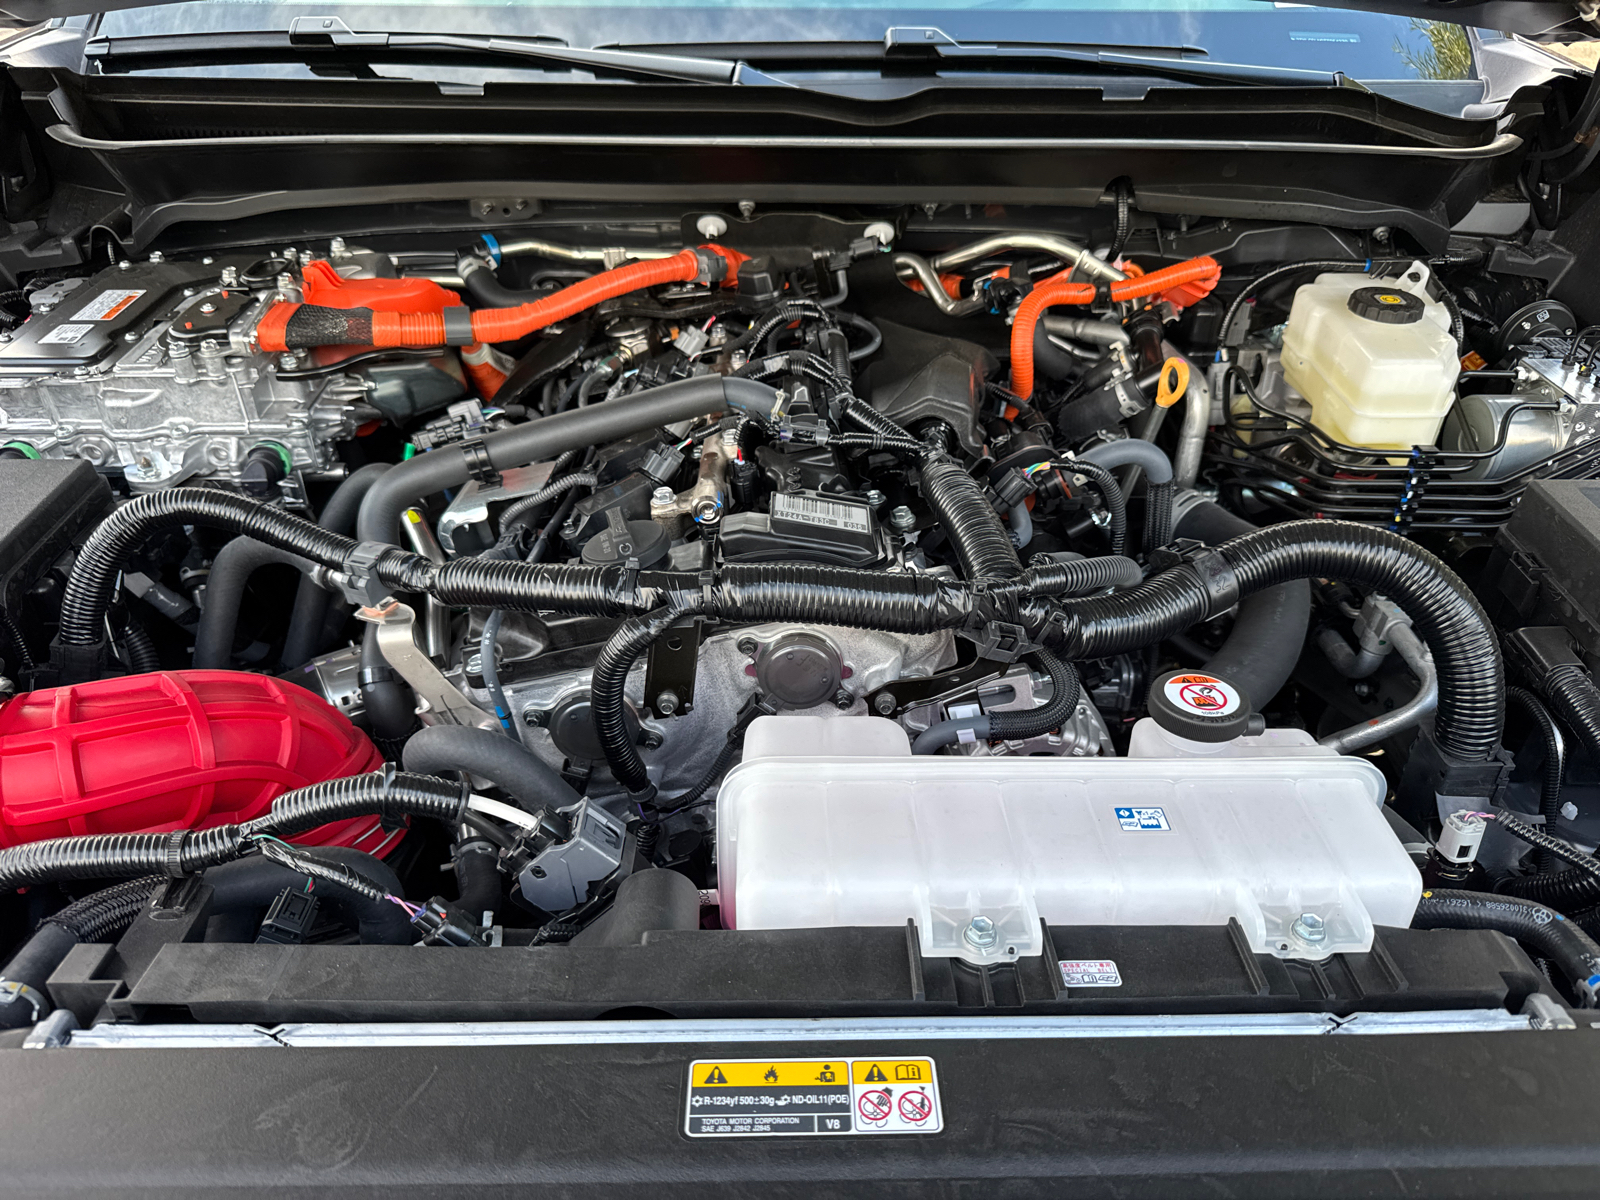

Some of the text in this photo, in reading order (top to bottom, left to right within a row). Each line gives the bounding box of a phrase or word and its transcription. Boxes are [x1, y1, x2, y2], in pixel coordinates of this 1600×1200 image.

[703, 1096, 738, 1108] R-1234yf
[792, 1094, 850, 1106] ND-OIL11(POE)
[729, 1117, 753, 1125] MOTOR
[754, 1117, 800, 1125] CORPORATION
[826, 1119, 841, 1130] V8
[701, 1124, 771, 1133] SAE J639 J2842 J2845
